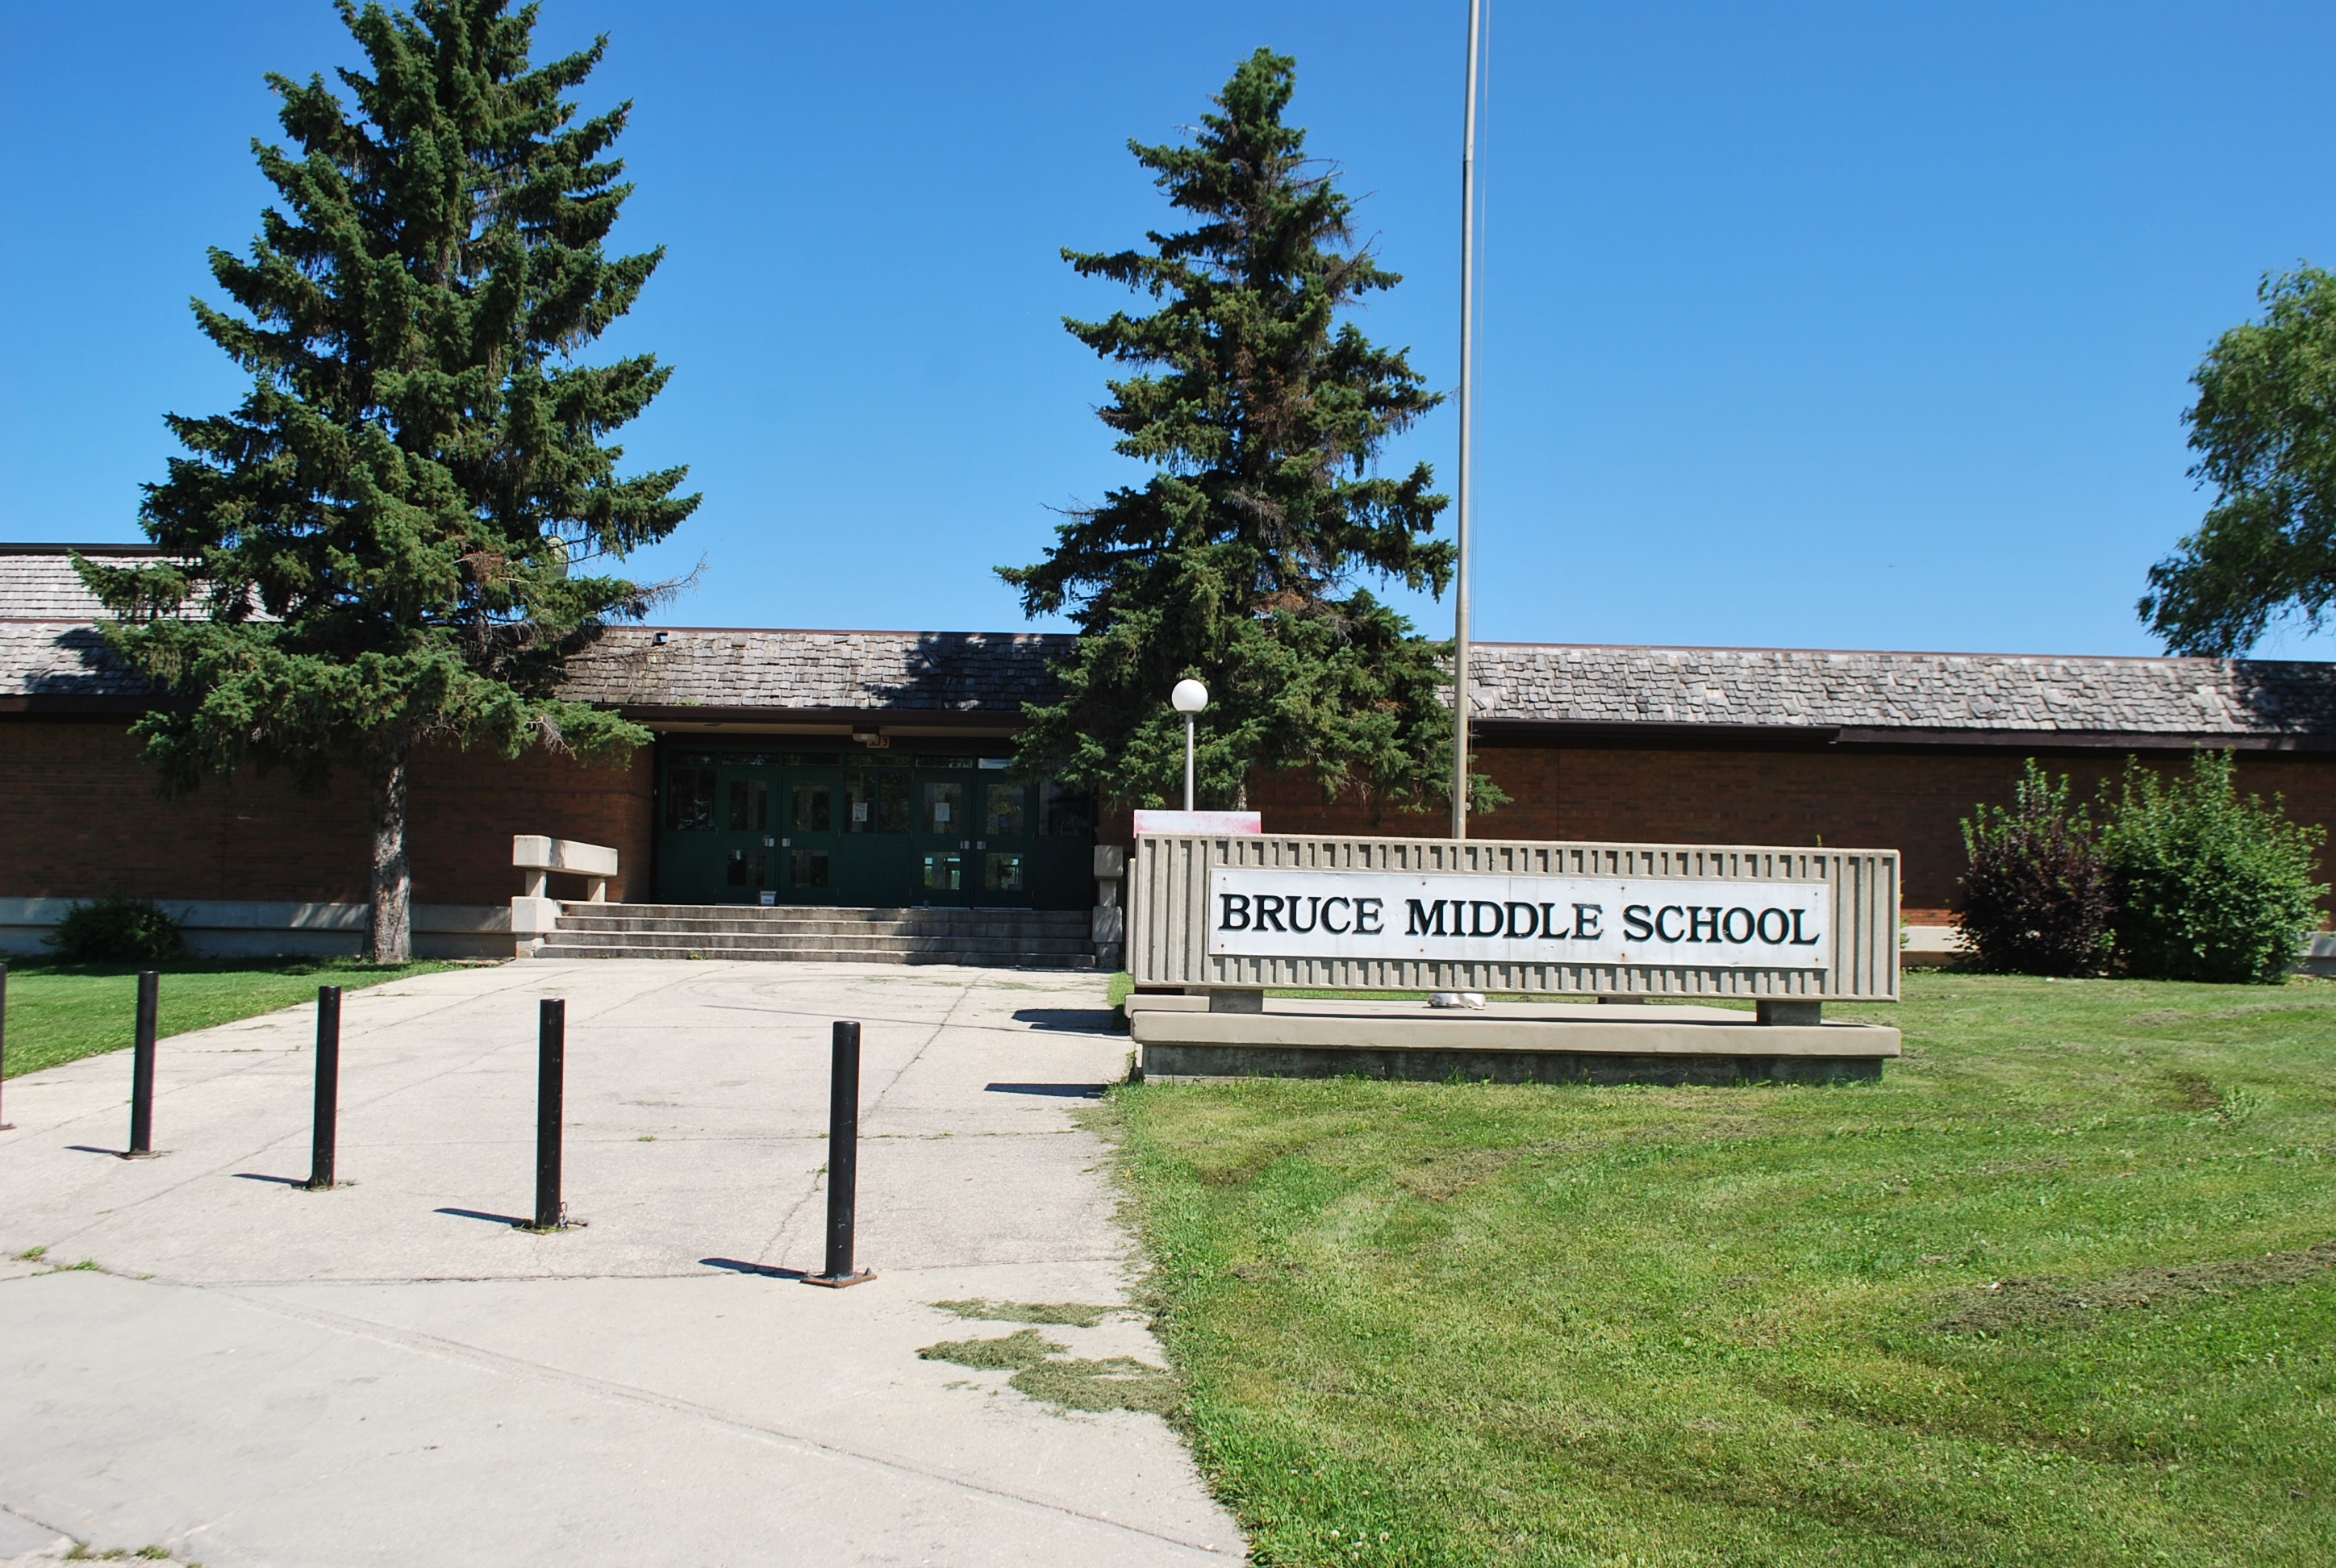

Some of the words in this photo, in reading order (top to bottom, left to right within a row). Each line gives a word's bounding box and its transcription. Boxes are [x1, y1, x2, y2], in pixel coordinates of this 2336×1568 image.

[1218, 893, 1384, 935] BRUCE
[1404, 899, 1603, 940] MIDDLE
[1623, 904, 1820, 945] SCHOOL
